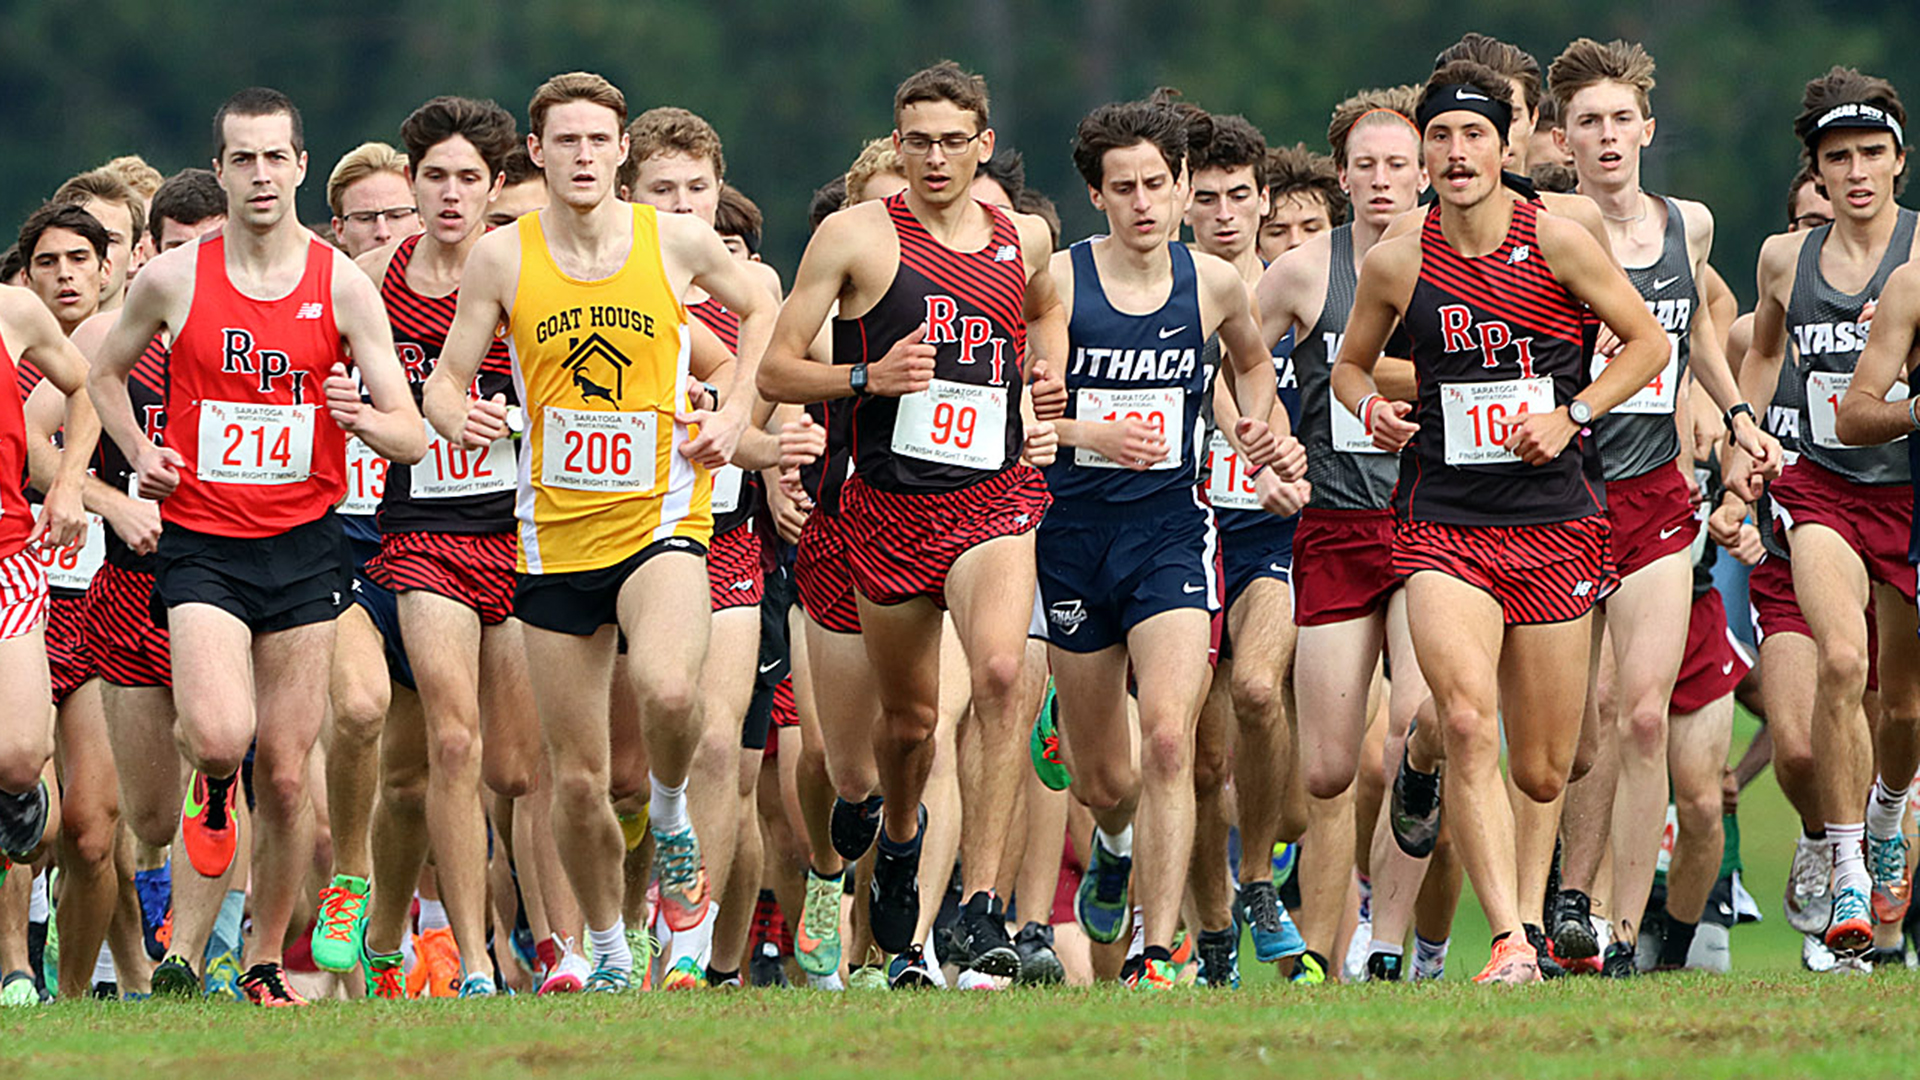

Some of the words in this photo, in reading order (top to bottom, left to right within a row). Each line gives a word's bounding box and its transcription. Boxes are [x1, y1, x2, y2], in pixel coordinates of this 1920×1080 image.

[536, 307, 582, 344] GOAT
[590, 306, 655, 339] HOUSE
[923, 295, 1007, 385] RPI
[1438, 304, 1540, 380] RPI
[1794, 321, 1871, 356] VASS
[221, 327, 309, 406] RPI
[1071, 347, 1195, 381] ITHACA
[1471, 385, 1519, 395] SARATOGA
[234, 406, 284, 417] SARATOGA
[573, 413, 623, 424] SARATOGA
[930, 402, 977, 449] 99
[222, 423, 292, 468] 214
[564, 430, 632, 476] 206
[210, 468, 239, 478] FINISH
[241, 470, 268, 480] RIGHT
[270, 471, 297, 480] TIMING
[351, 457, 389, 499] 13
[448, 482, 474, 492] RIGHT
[475, 479, 505, 489] TIMING
[554, 475, 581, 485] FINISH
[582, 479, 609, 487] RIGHT
